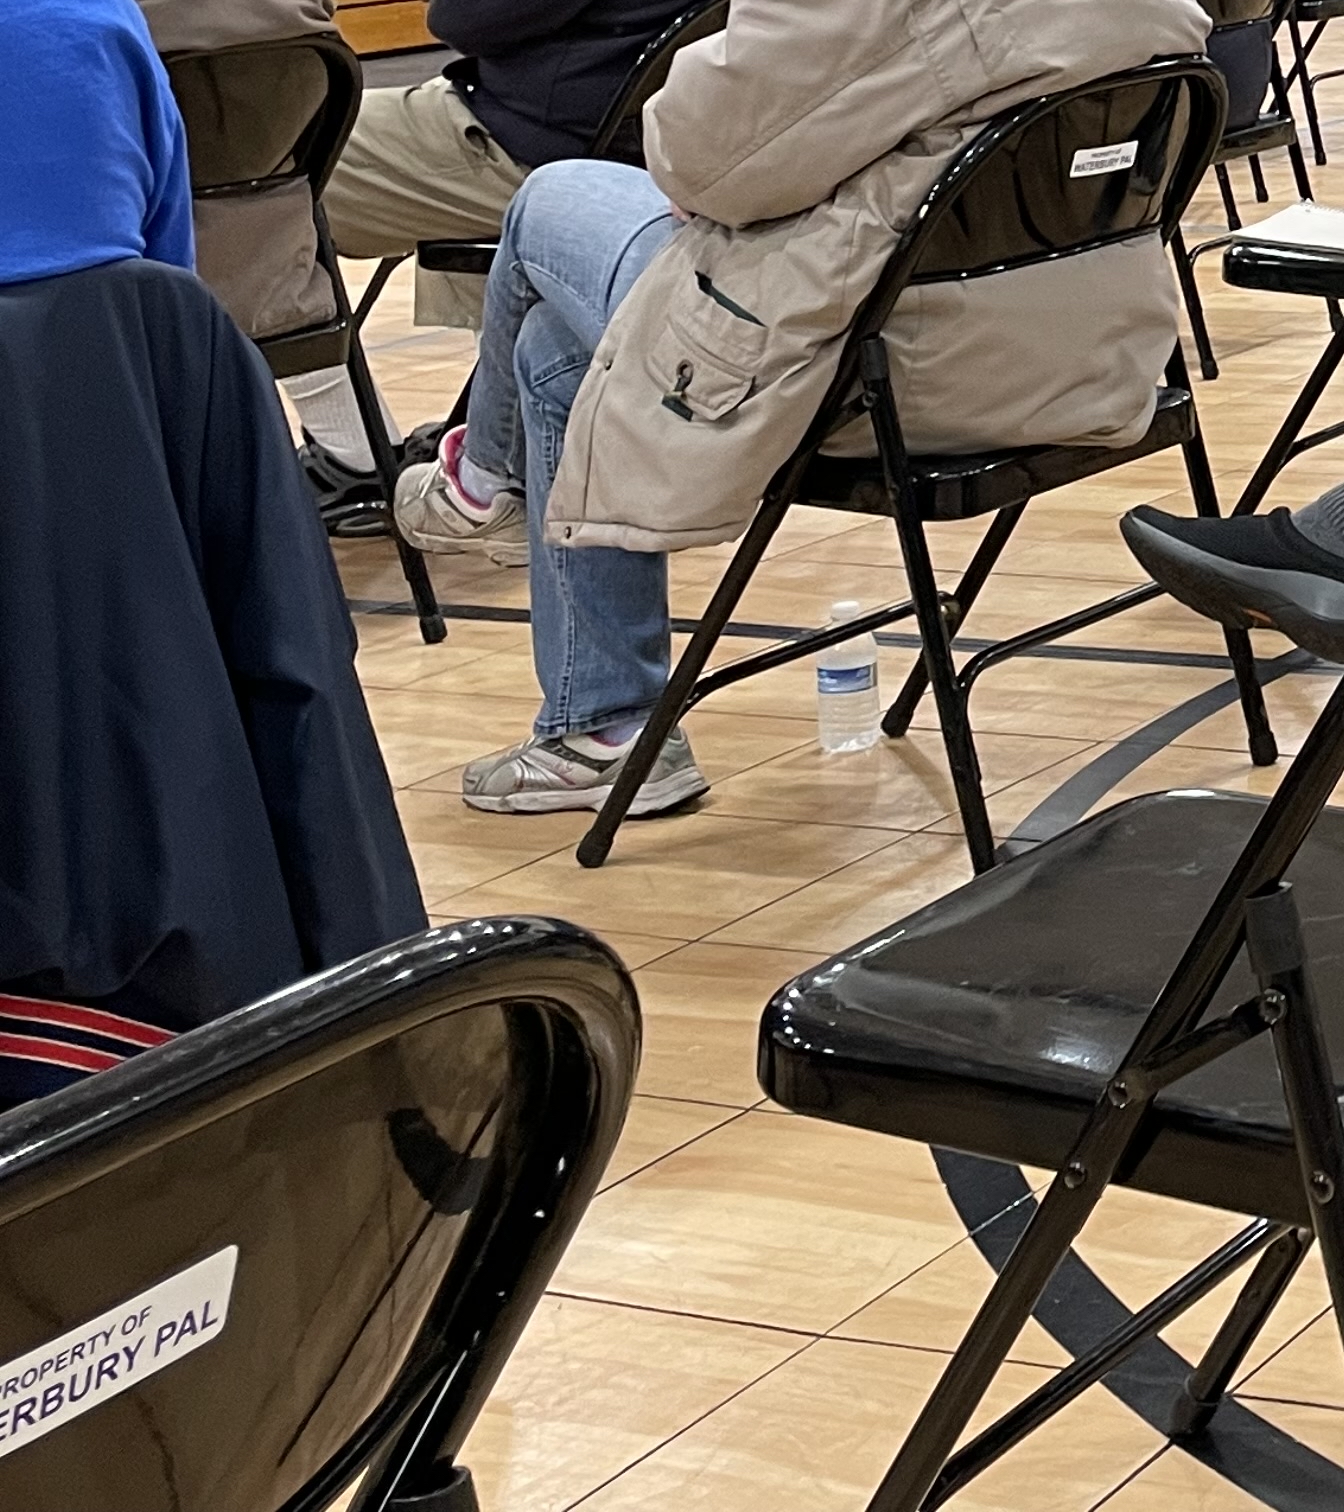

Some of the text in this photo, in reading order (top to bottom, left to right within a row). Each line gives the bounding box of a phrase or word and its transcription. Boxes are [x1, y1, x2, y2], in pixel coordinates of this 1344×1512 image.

[0, 1304, 153, 1400] ROPERTY OF
[153, 1299, 220, 1358] PAL
